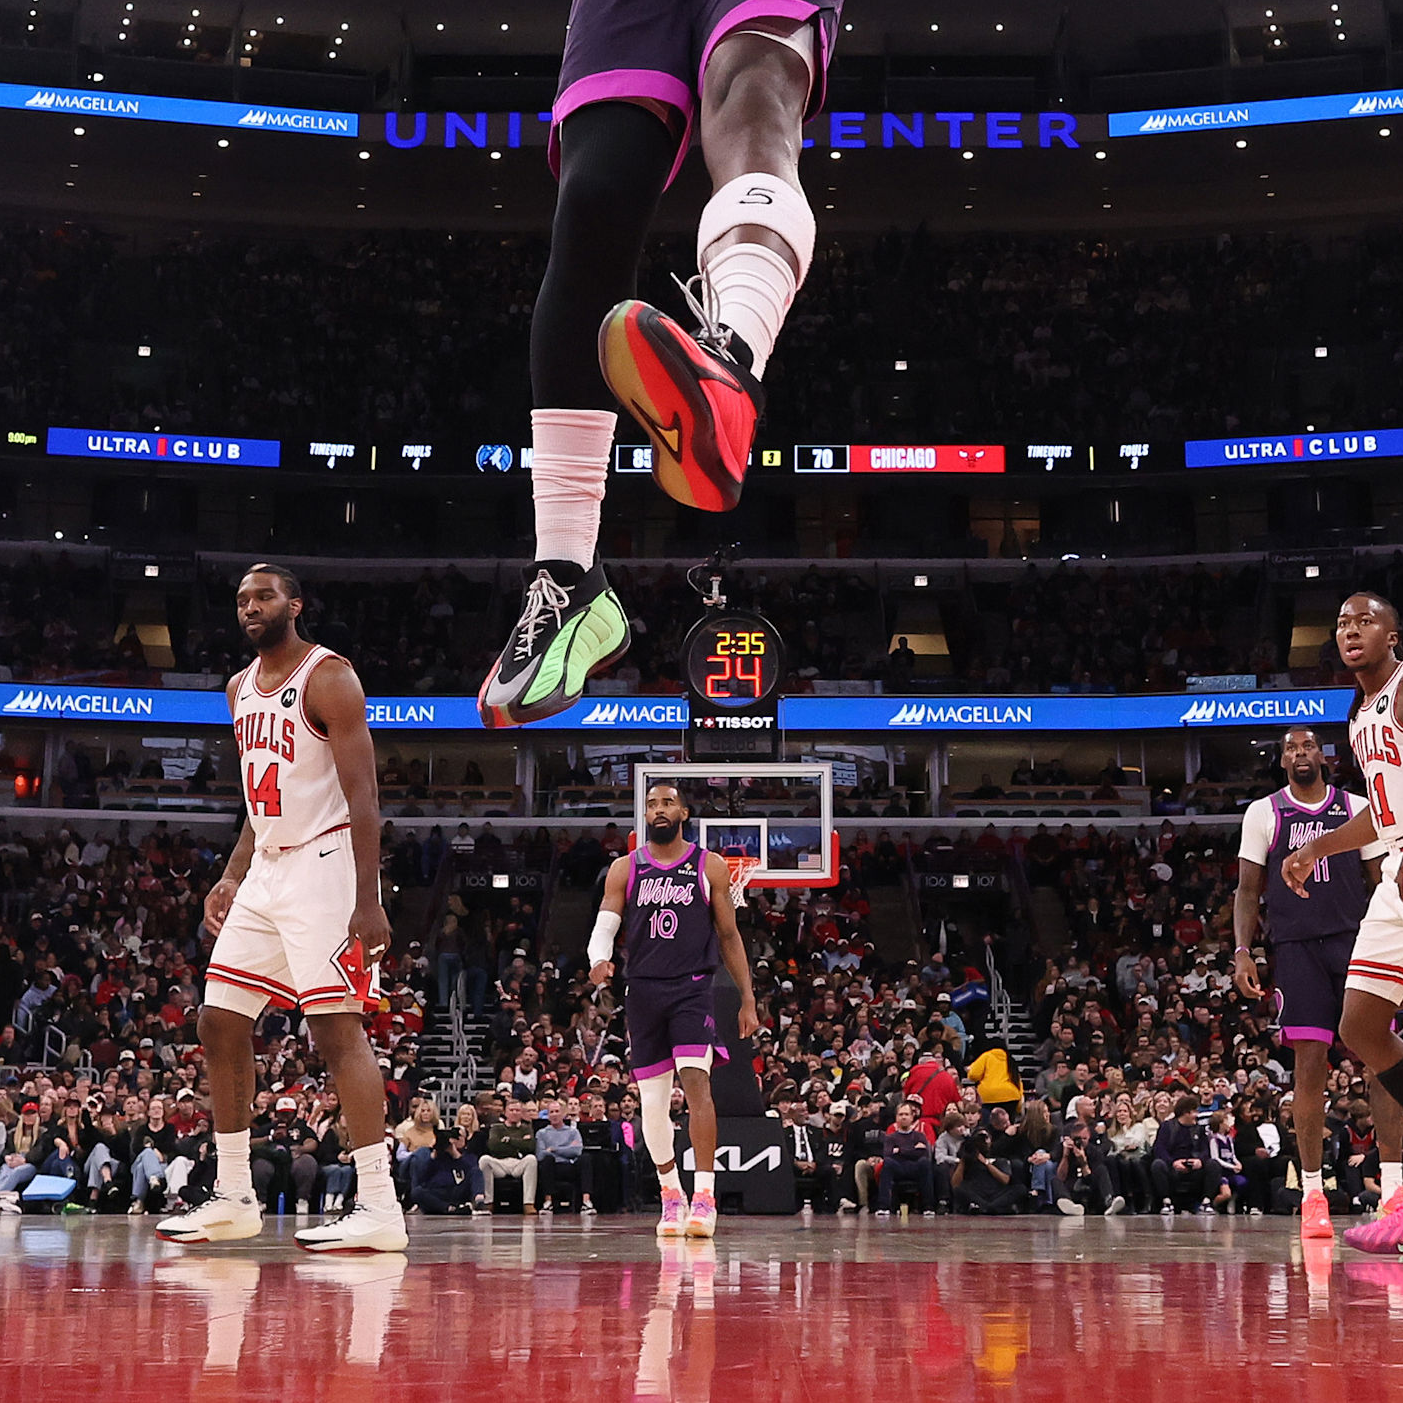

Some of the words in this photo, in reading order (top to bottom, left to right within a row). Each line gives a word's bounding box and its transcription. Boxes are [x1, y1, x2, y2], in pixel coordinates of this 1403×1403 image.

[55, 95, 139, 115] MAGELLAN
[267, 113, 348, 132] MAGELLAN
[1168, 108, 1249, 128] MAGELLAN
[801, 112, 1080, 149] ENTER
[88, 436, 150, 455] ULTRA
[173, 440, 242, 460] CLUB
[310, 443, 355, 459] TIMEOUTS
[402, 444, 432, 459] FOULS
[811, 449, 834, 468] 70
[870, 446, 937, 469] CHICAGO
[1027, 445, 1073, 459] TIMEOUTS
[1119, 444, 1150, 459] FOULS
[1224, 442, 1287, 460] ULTRA
[1309, 435, 1378, 456] CLUB
[327, 456, 336, 470] 4
[412, 456, 421, 470] 4
[768, 451, 775, 465] 3
[1045, 457, 1054, 471] 3
[1130, 457, 1139, 470] 3
[716, 632, 766, 656] 2:35
[705, 655, 762, 699] 24
[43, 695, 152, 715] MAGELLAN
[366, 704, 434, 723] GELLAN
[927, 704, 1032, 723] MAGELLAN
[1217, 698, 1325, 719] MAGELLAN
[716, 715, 774, 729] TISSOT
[235, 711, 295, 764] BULLS
[248, 761, 282, 818] 14
[637, 877, 695, 908] Wolves
[649, 908, 678, 939] 10
